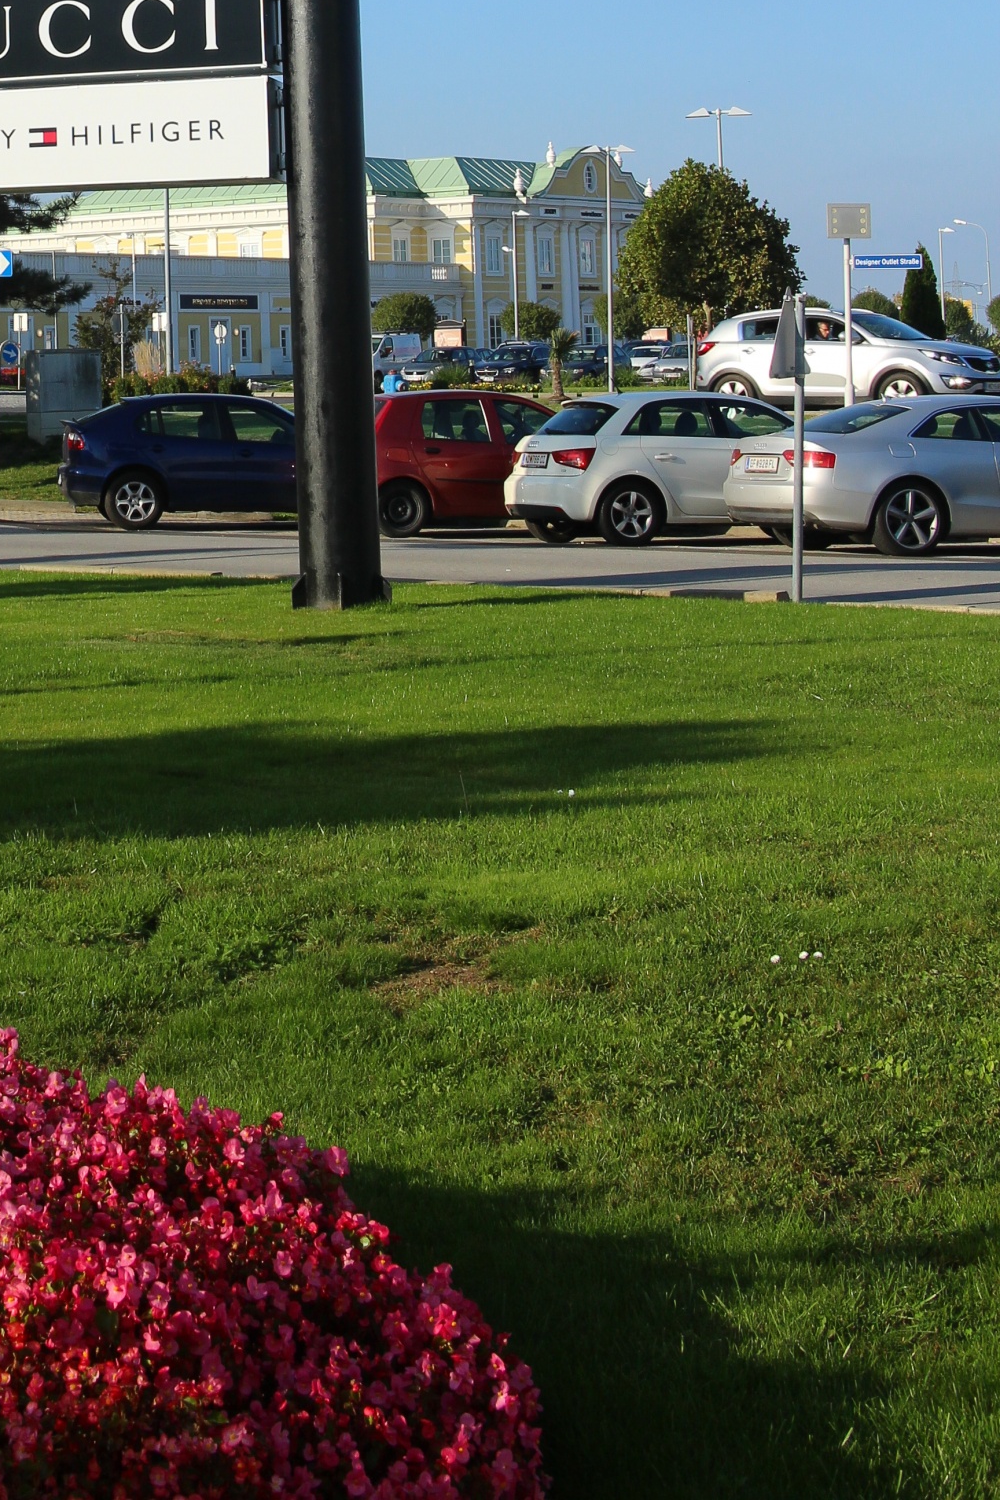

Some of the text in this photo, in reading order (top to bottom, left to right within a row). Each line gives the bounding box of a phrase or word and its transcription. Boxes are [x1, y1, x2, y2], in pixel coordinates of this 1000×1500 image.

[71, 119, 226, 147] HILFIGER
[855, 258, 881, 267] Designer
[900, 257, 919, 265] Straße
